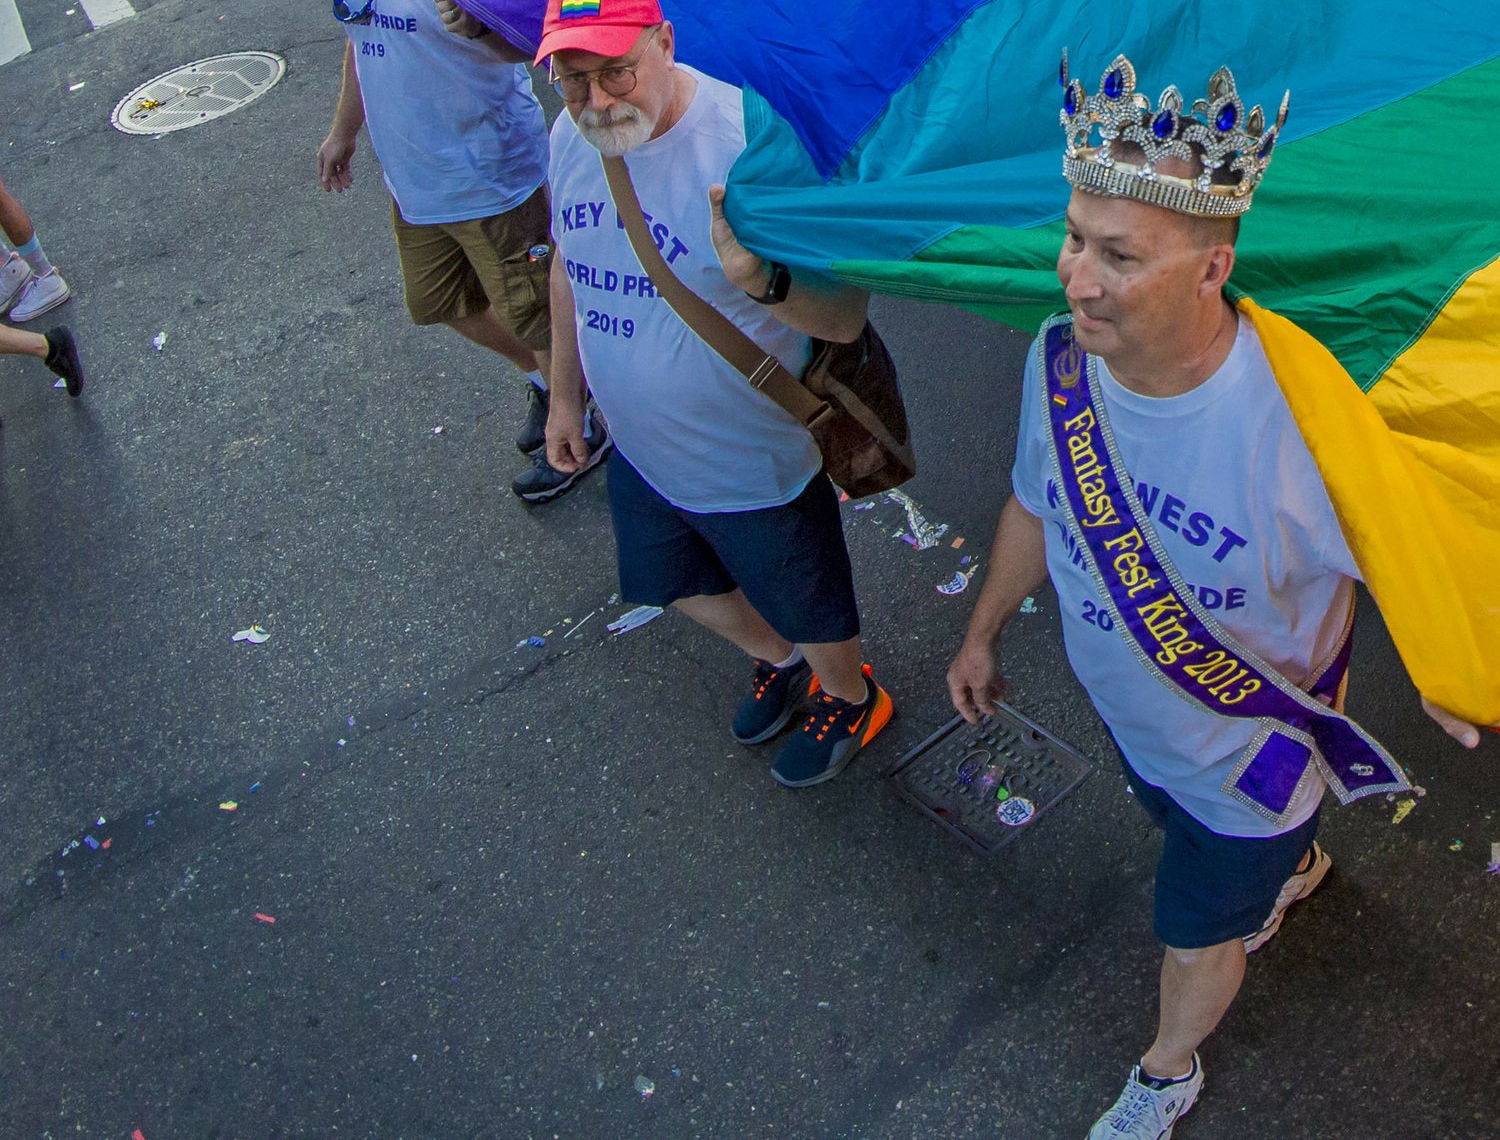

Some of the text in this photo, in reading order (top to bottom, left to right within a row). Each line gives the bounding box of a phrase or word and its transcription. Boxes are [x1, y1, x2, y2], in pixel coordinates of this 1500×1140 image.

[374, 13, 417, 32] PRIDE
[362, 41, 385, 57] 2019
[562, 202, 605, 233] KEY
[563, 257, 618, 292] ORLD
[587, 310, 635, 338] 2019
[1064, 406, 1121, 528] Fantasy
[1103, 527, 1161, 599] Fest
[1137, 592, 1204, 666] King
[1182, 649, 1262, 705] 2013
[1081, 600, 1114, 632] 20
